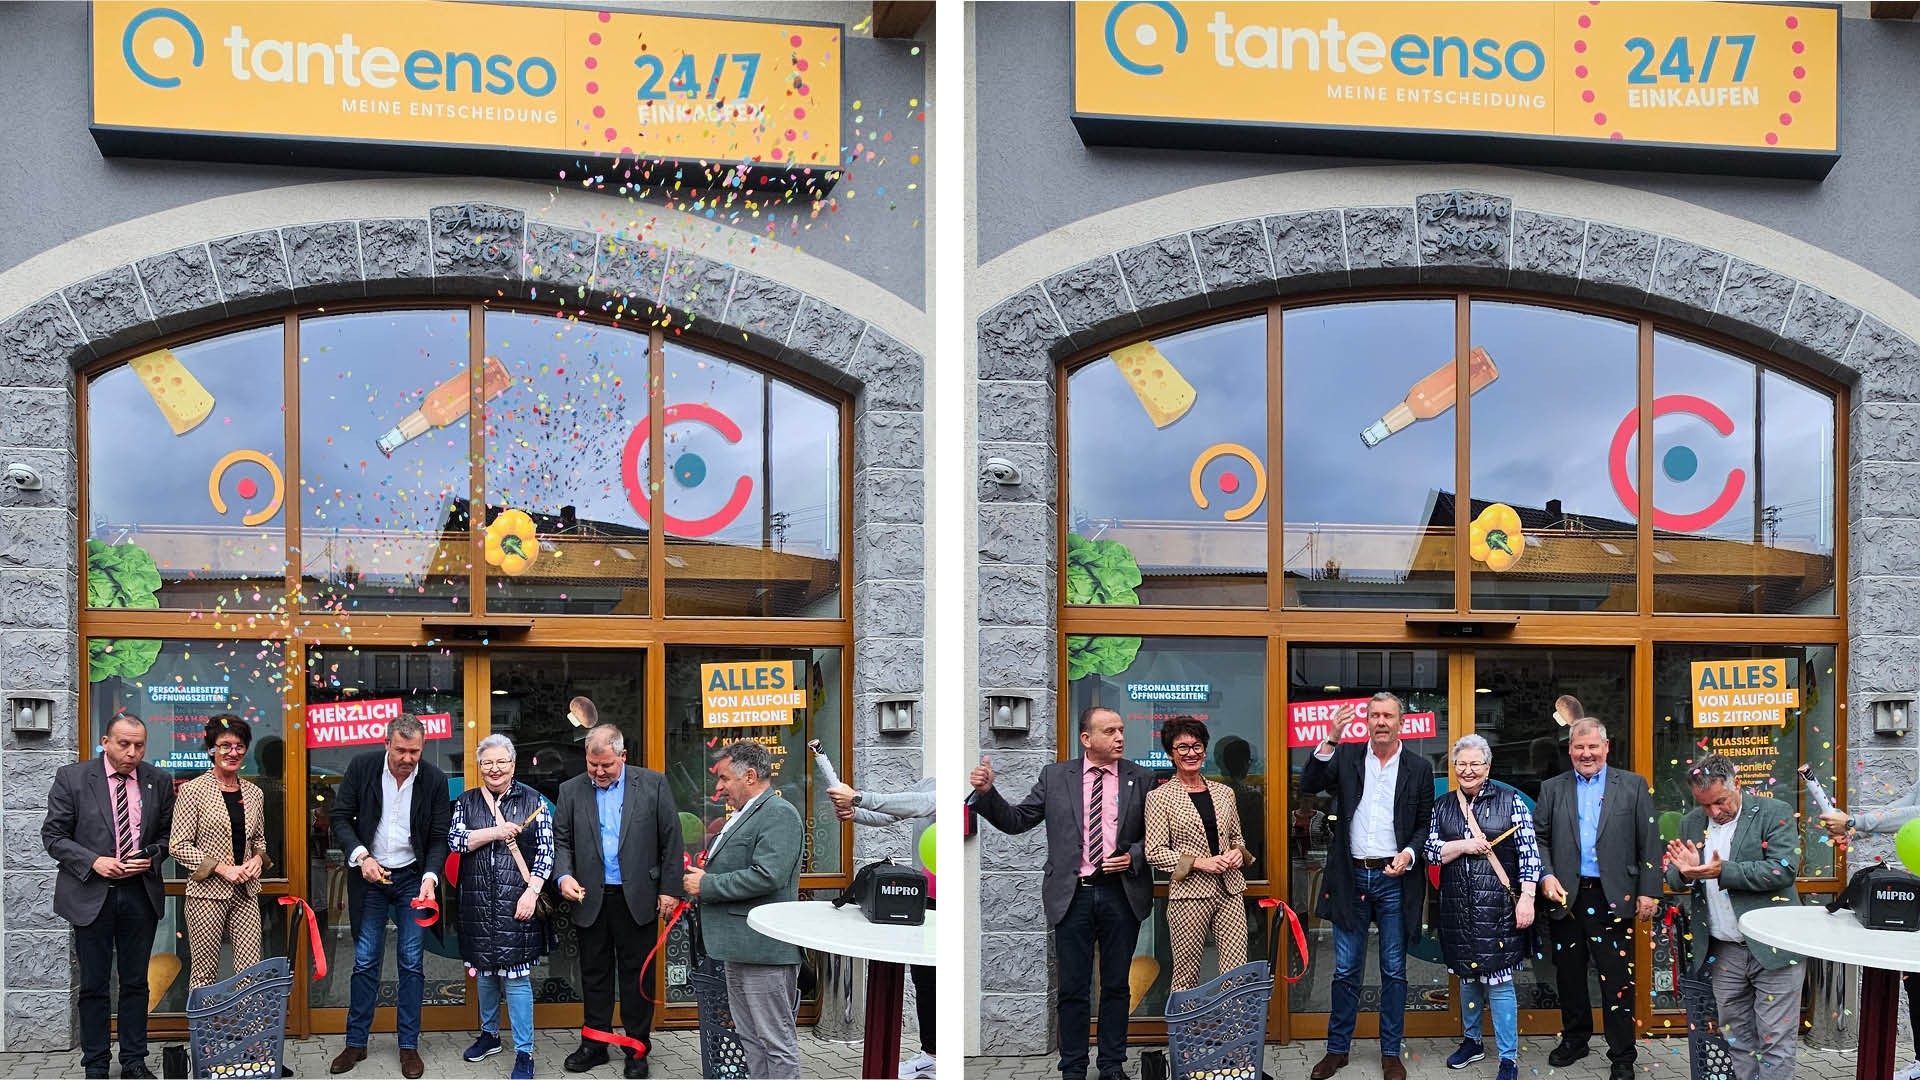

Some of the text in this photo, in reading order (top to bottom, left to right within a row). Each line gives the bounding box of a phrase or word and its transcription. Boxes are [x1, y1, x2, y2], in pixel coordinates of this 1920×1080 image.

[1207, 10, 1545, 82] tanteenso
[223, 24, 557, 97] tanteenso
[1624, 35, 1756, 84] 24/7
[634, 53, 761, 100] 24/7
[1327, 83, 1545, 109] MEINE ENTSCHEIDUNG
[1628, 86, 1760, 107] EINKAUFEN
[341, 97, 558, 124] MEINE ENTSCHEIDUNG
[707, 667, 785, 691] ALLES
[1698, 665, 1778, 690] ALLES
[148, 686, 229, 694] PERSONALBESETZTE
[1127, 684, 1209, 692] PERSONALBESETZTE
[1131, 690, 1207, 700] ÖFFNUNGSZEITEN:
[708, 693, 801, 708] VON ALUFOLIE
[1698, 691, 1793, 707] VON ALUFOLIE
[312, 703, 398, 724] HERZLICH
[708, 710, 787, 724] BIS ZITRONE
[1698, 709, 1780, 724] BIS ZITRONE
[1712, 736, 1769, 747] KLASSISCHE
[171, 752, 208, 760] ZU ALLEN
[1150, 751, 1162, 760] ZU
